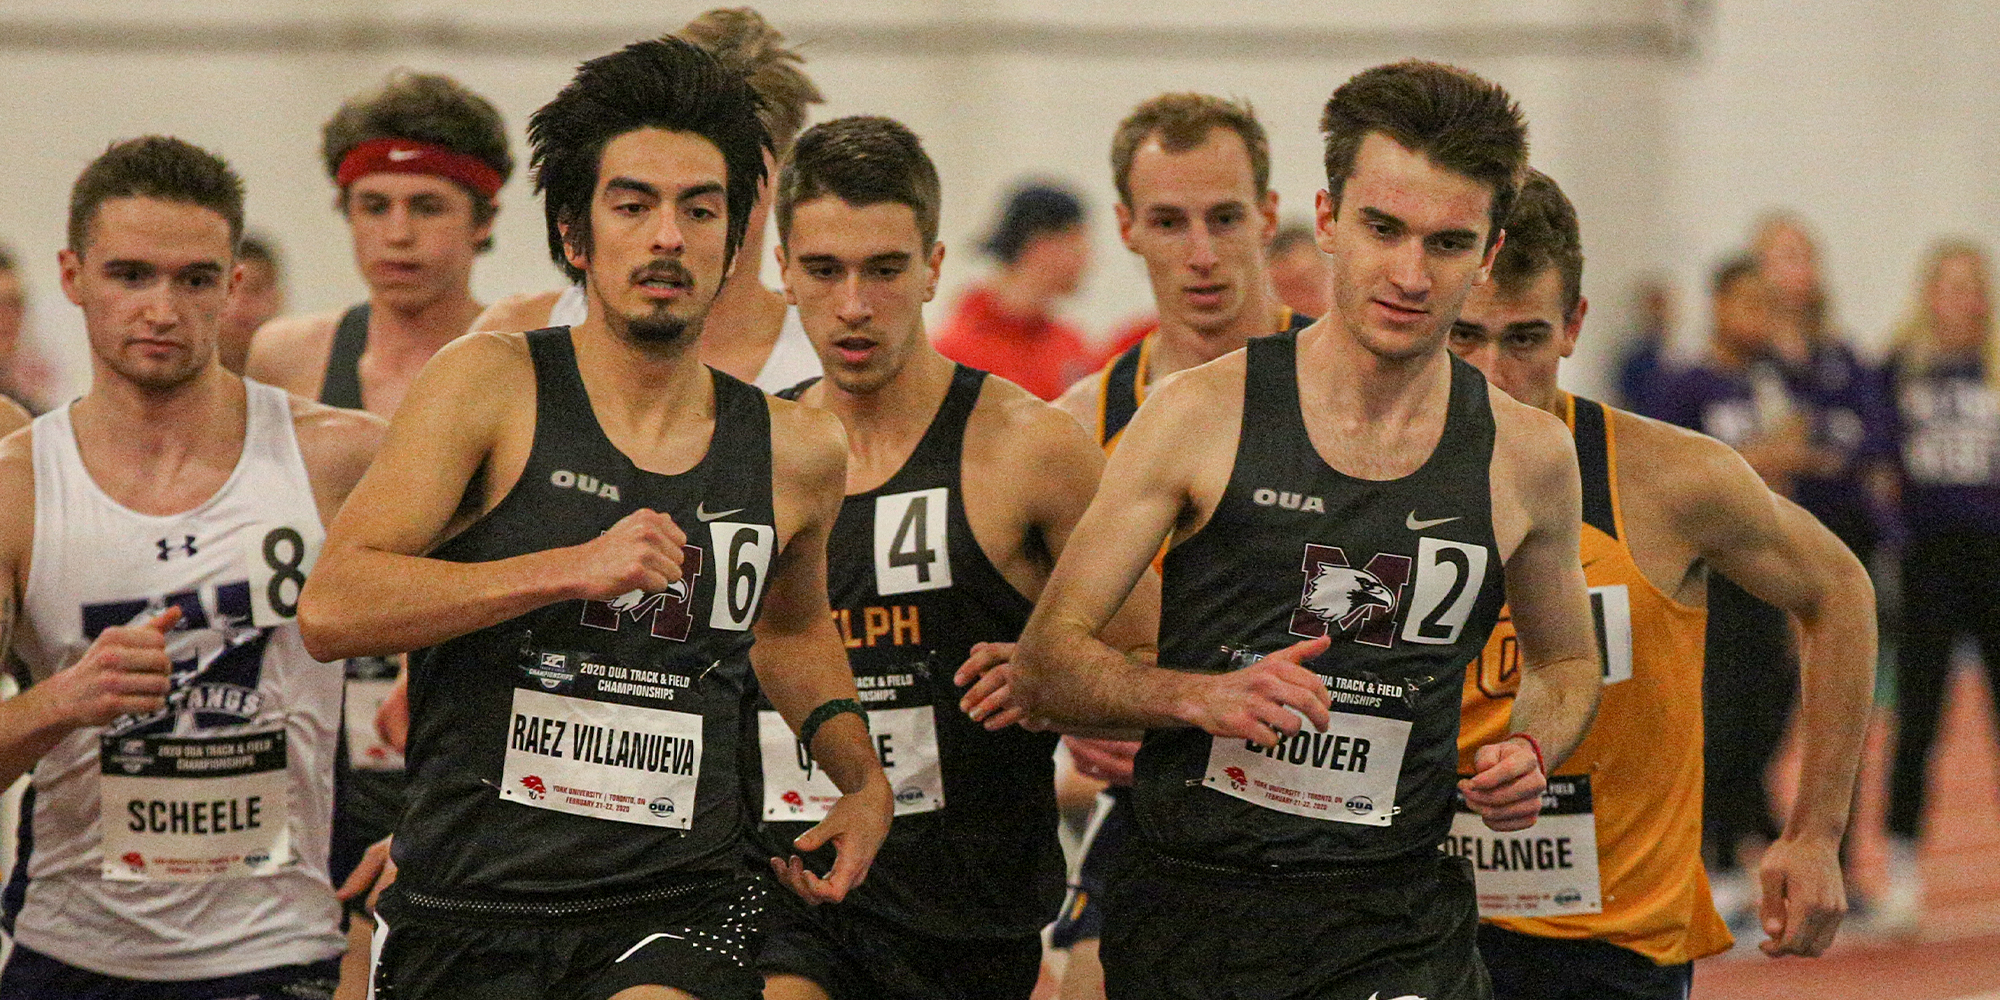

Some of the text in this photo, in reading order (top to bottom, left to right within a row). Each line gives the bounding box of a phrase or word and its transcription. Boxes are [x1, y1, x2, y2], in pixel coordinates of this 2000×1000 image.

[551, 470, 620, 501] OUA
[1253, 488, 1325, 513] OUA
[889, 496, 937, 584] 4
[262, 527, 307, 618] 8
[727, 527, 759, 624] 6
[1417, 547, 1470, 638] 2
[831, 605, 921, 648] LPH
[580, 662, 690, 688] 2020 OUA TRACK & FIELD
[1336, 677, 1366, 692] TRACK
[1366, 682, 1375, 694] &
[1377, 683, 1403, 698] FIELD
[598, 679, 674, 700] CHAMPIONSHIPS
[512, 714, 694, 776] RAEZ VILLANUEVA
[553, 785, 568, 794] YORK
[569, 788, 602, 800] UNIVERSITY
[566, 796, 595, 807] FEBRUARY
[1346, 801, 1373, 811] OUA
[127, 796, 261, 834] SCHEELE
[648, 803, 675, 813] OUA
